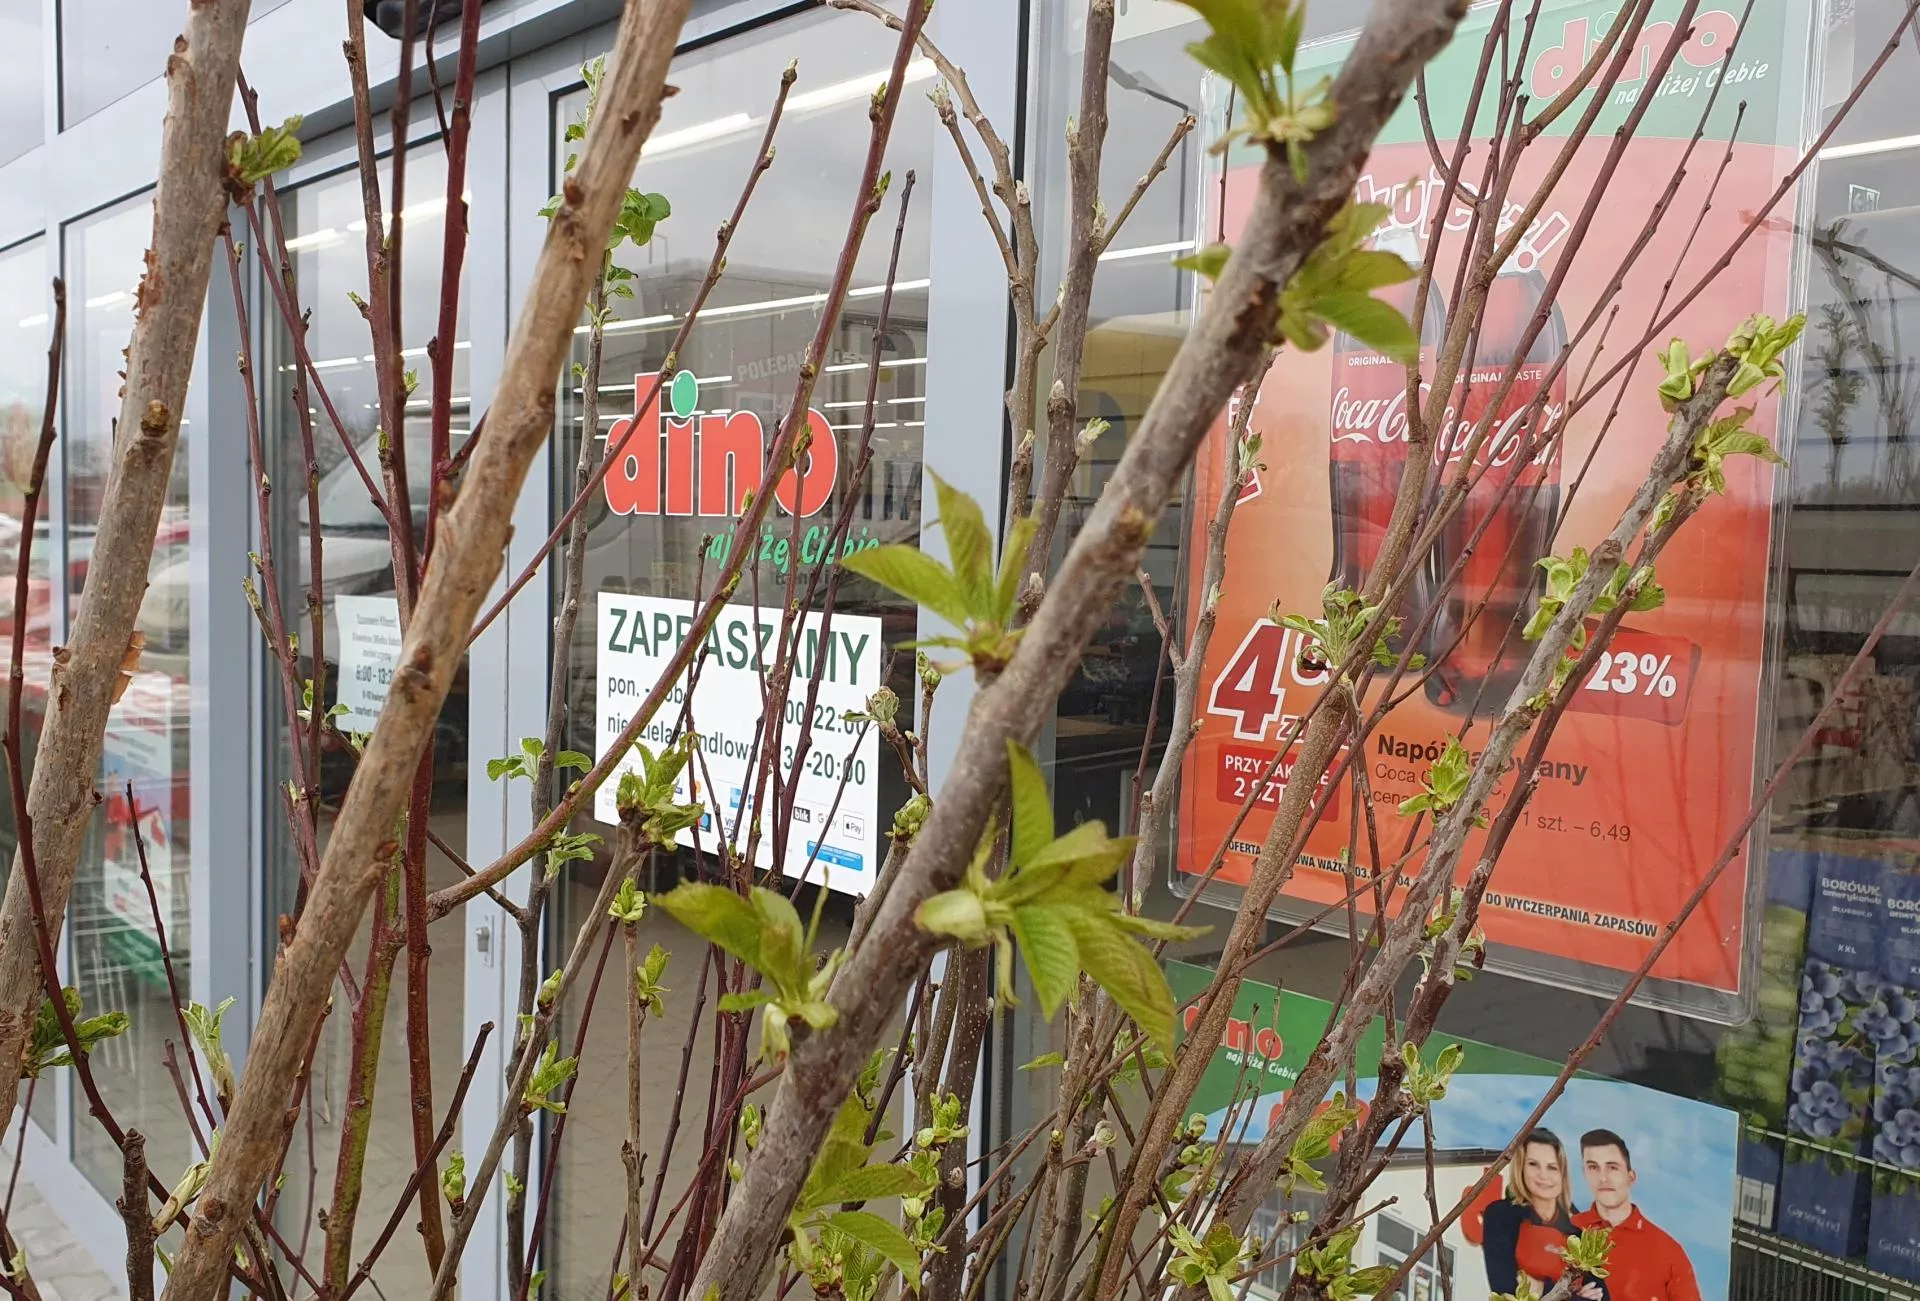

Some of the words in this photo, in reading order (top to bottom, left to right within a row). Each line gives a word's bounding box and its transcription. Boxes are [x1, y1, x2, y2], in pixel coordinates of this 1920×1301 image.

[1614, 72, 1702, 105] naliżej
[1704, 60, 1769, 88] Cebie
[736, 351, 801, 382] POLECA
[1348, 354, 1393, 367] ORIGINAL
[1454, 373, 1502, 385] ORGINA
[1515, 369, 1542, 380] ASTE
[1331, 386, 1432, 444] Coca-C
[603, 369, 838, 518] dino
[377, 667, 395, 685] 13:3
[608, 675, 640, 698] pon.
[1206, 617, 1290, 742] 4
[607, 712, 673, 745] nieiela
[1225, 754, 1263, 774] PRZY
[1375, 763, 1416, 784] Coca
[1233, 776, 1246, 798] 2
[794, 806, 811, 822] blik
[850, 822, 862, 835] Pay
[1537, 812, 1568, 833] szt.
[1590, 820, 1632, 843] 6,49
[1228, 840, 1261, 856] OFERTA
[1821, 877, 1881, 896] BORÓWK
[1485, 891, 1501, 906] DO
[1504, 896, 1591, 925] WYCZERPANIA
[1593, 912, 1659, 938] ZAPASÓW
[1837, 943, 1857, 955] XXL
[1183, 996, 1283, 1061] dno
[1268, 1060, 1299, 1081] Ciebie
